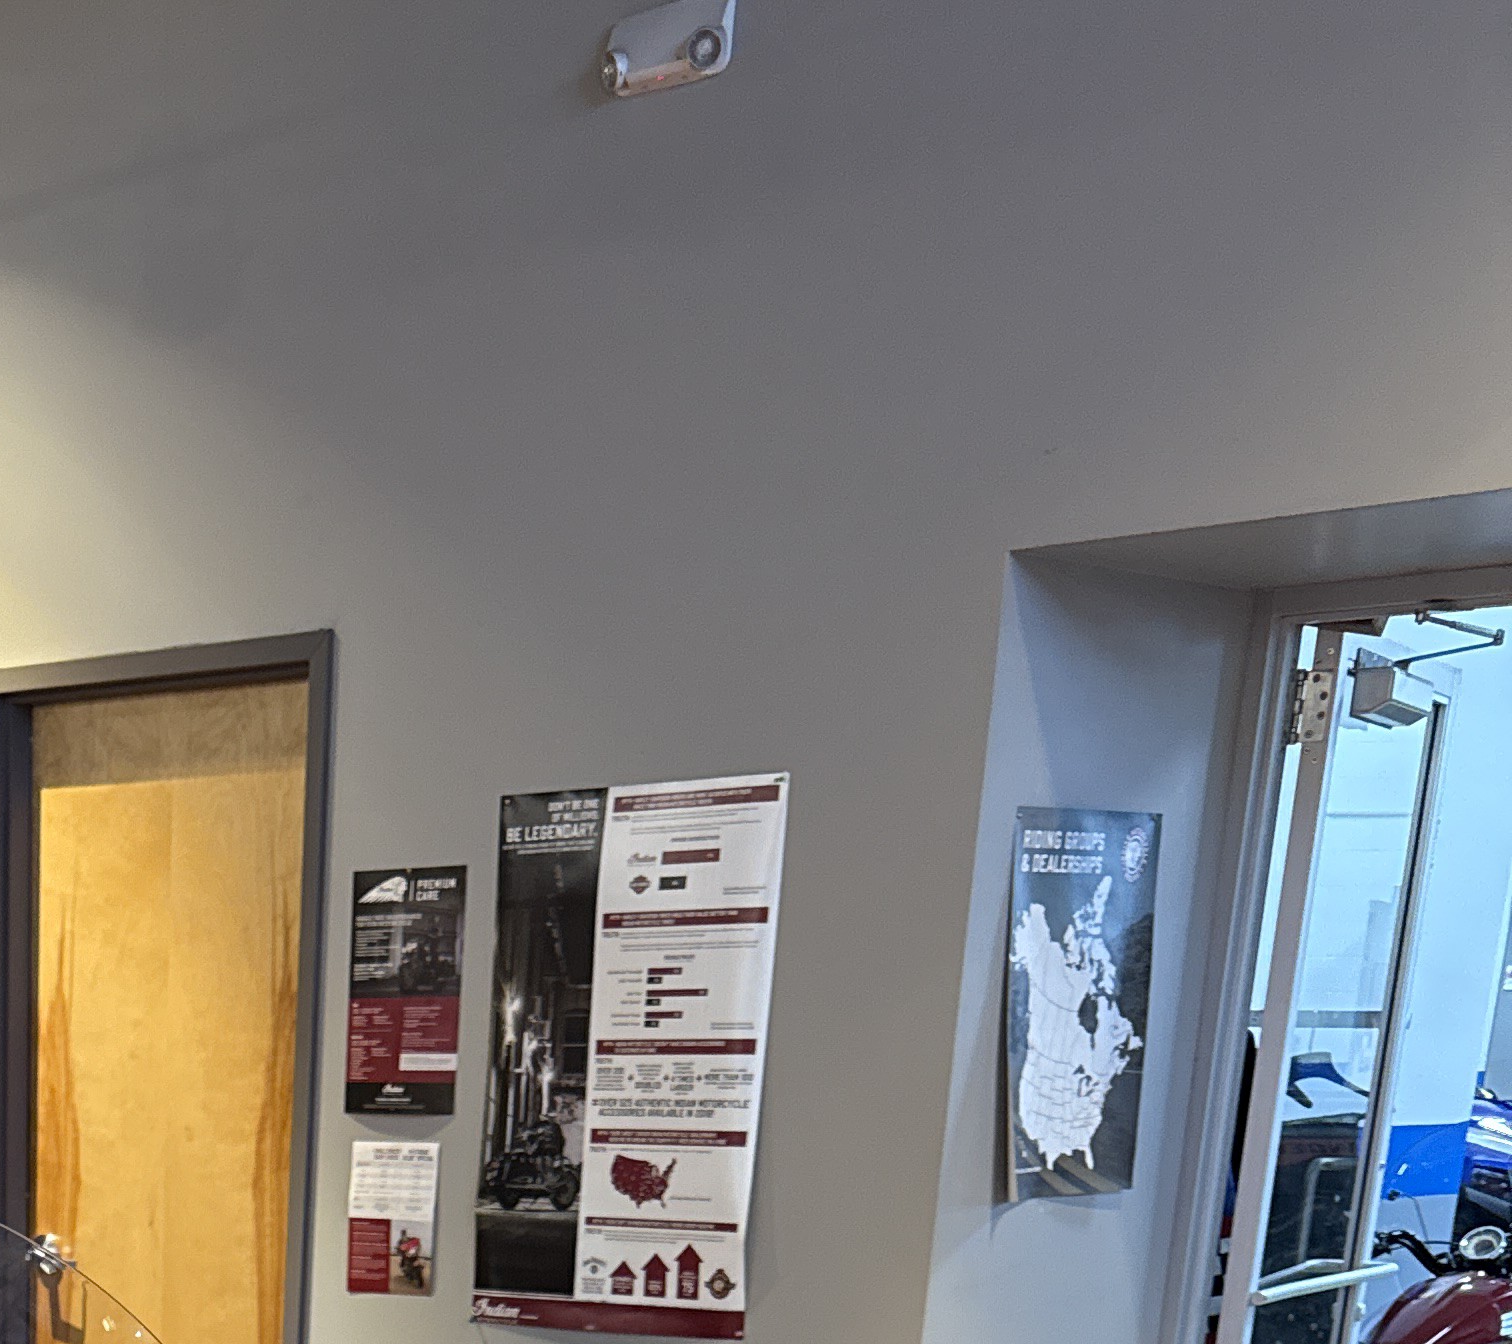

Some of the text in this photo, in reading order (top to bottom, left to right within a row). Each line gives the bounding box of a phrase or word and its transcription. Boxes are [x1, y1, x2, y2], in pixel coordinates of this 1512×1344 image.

[506, 827, 523, 843] BE
[524, 821, 598, 841] LEGENDARY.
[1023, 830, 1106, 851] RIDING GROUPS
[1031, 854, 1103, 874] DEALERSHIPS
[472, 1298, 520, 1318] Indian
